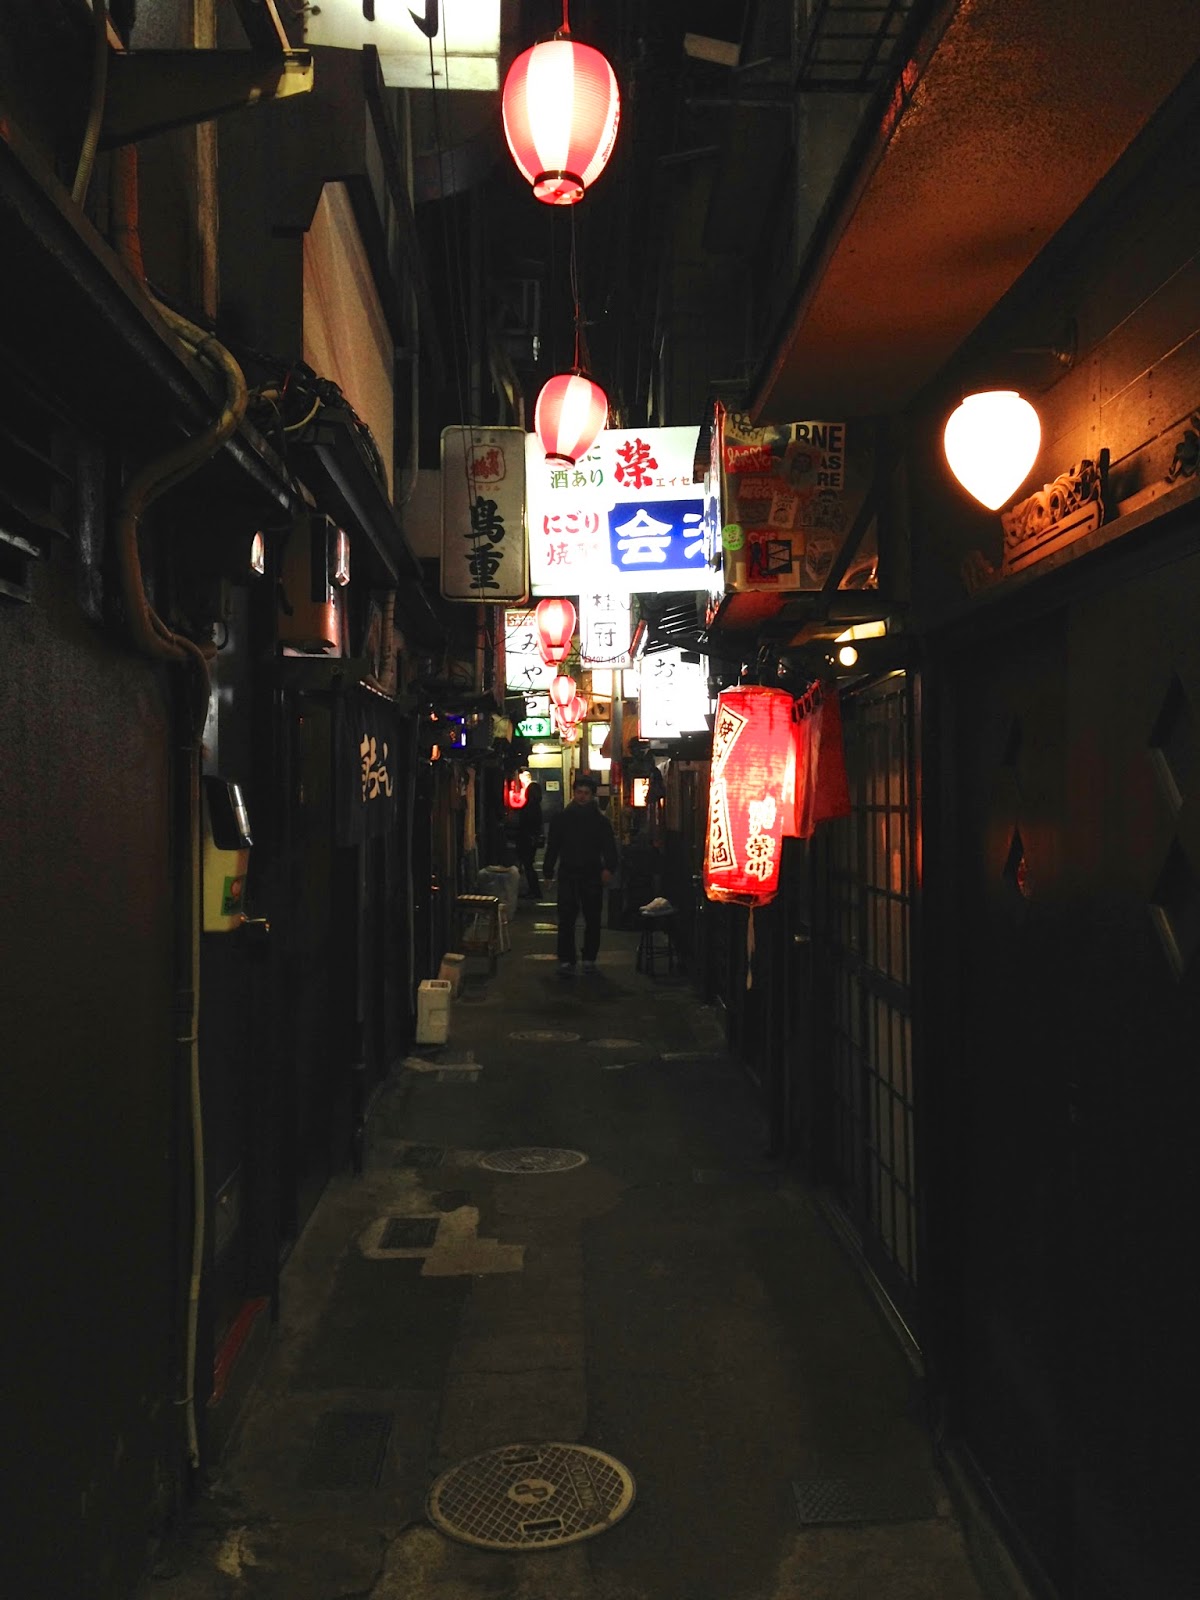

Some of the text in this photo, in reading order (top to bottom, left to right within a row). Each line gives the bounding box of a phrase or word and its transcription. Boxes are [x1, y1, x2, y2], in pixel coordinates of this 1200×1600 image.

[795, 424, 843, 453] BNE
[819, 455, 842, 470] AS
[656, 476, 691, 487] エイセ
[816, 472, 841, 487] RE
[543, 509, 600, 536] にごり
[463, 496, 505, 590] 鳥重
